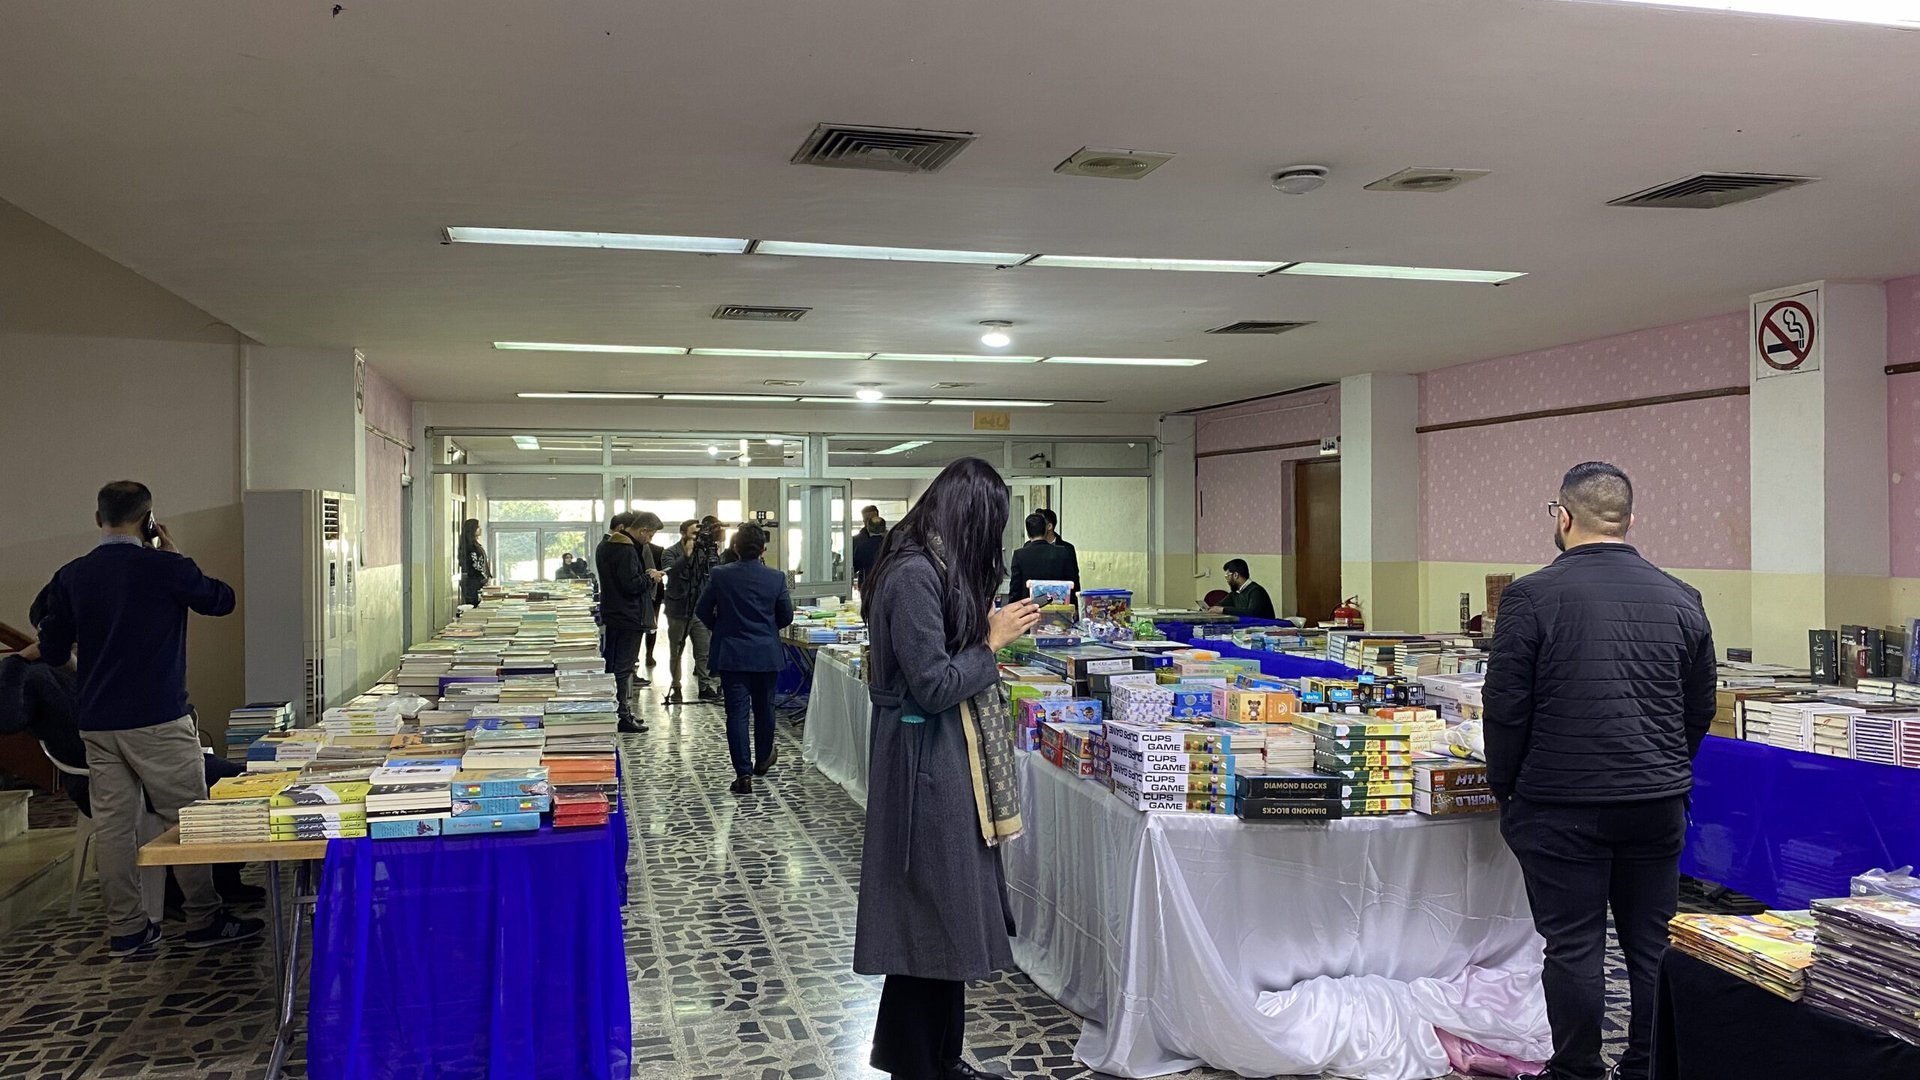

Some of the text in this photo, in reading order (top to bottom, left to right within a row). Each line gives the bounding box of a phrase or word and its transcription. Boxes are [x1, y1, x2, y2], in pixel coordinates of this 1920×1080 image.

[1108, 726, 1138, 742] CUPS GAME
[1142, 734, 1172, 742] CUPS
[1148, 743, 1181, 751] GAME
[1112, 744, 1143, 762] CUPS GAME
[1147, 754, 1177, 763] CUPS
[1153, 764, 1186, 772] GAME
[1144, 775, 1176, 783] CUPS
[1151, 784, 1185, 792] GAME
[1264, 782, 1328, 790] DIAMOND BLOCKS
[1143, 793, 1174, 801] CUPS
[1455, 794, 1496, 806] WORLD
[1149, 802, 1183, 810] GAME
[221, 922, 240, 937] N
